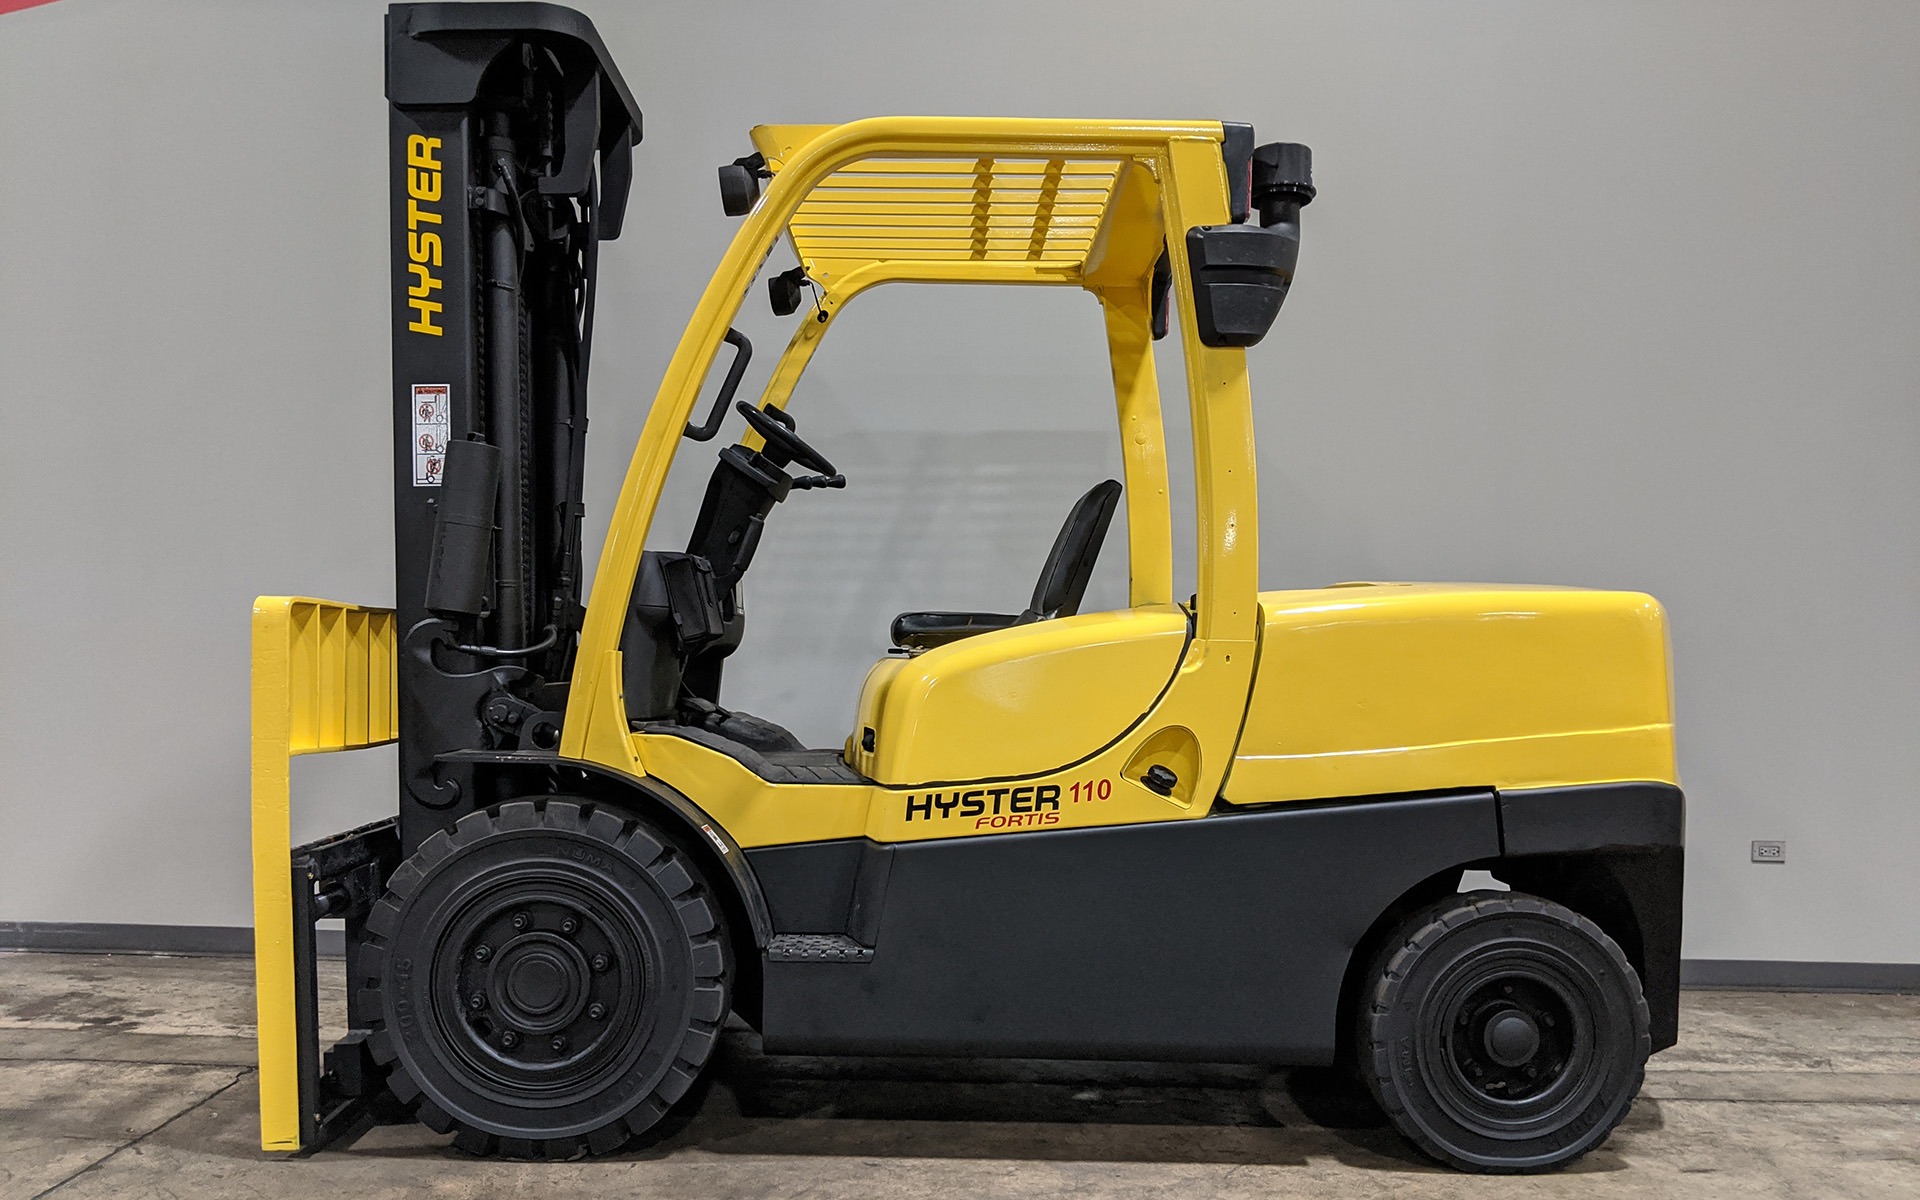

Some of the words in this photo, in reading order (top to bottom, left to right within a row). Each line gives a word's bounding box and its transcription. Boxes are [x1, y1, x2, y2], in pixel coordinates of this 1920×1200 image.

[407, 134, 443, 336] HYSTER
[905, 784, 1061, 822] HYSTER
[1069, 779, 1112, 803] 110
[975, 811, 1060, 830] FORTIS
